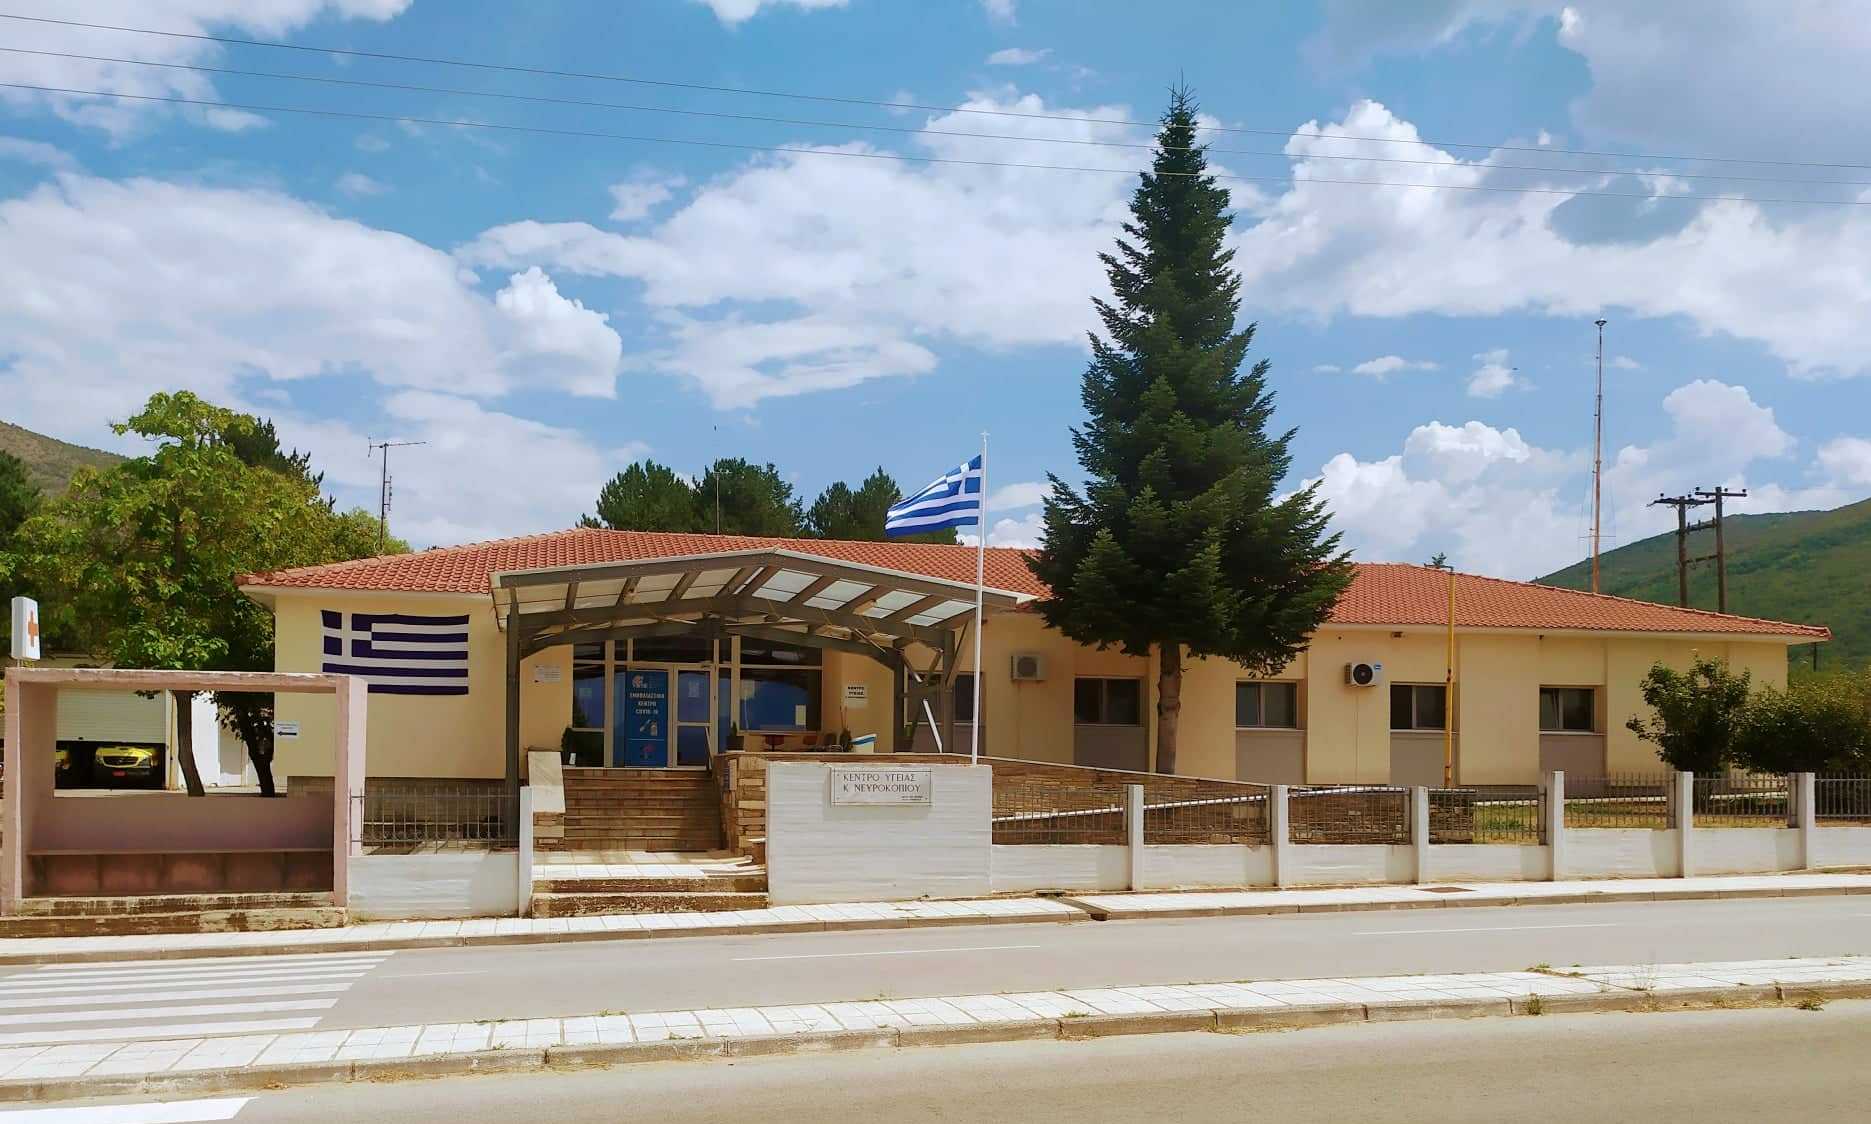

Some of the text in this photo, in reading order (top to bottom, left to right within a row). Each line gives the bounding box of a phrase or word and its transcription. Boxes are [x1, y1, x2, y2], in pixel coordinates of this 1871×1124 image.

[843, 773, 917, 782] ΚΕΝΤΡΟ ΥΓΕΙΑΣ
[854, 784, 920, 793] ΝΕΥΡΟΚΟΠΙΟΥ
